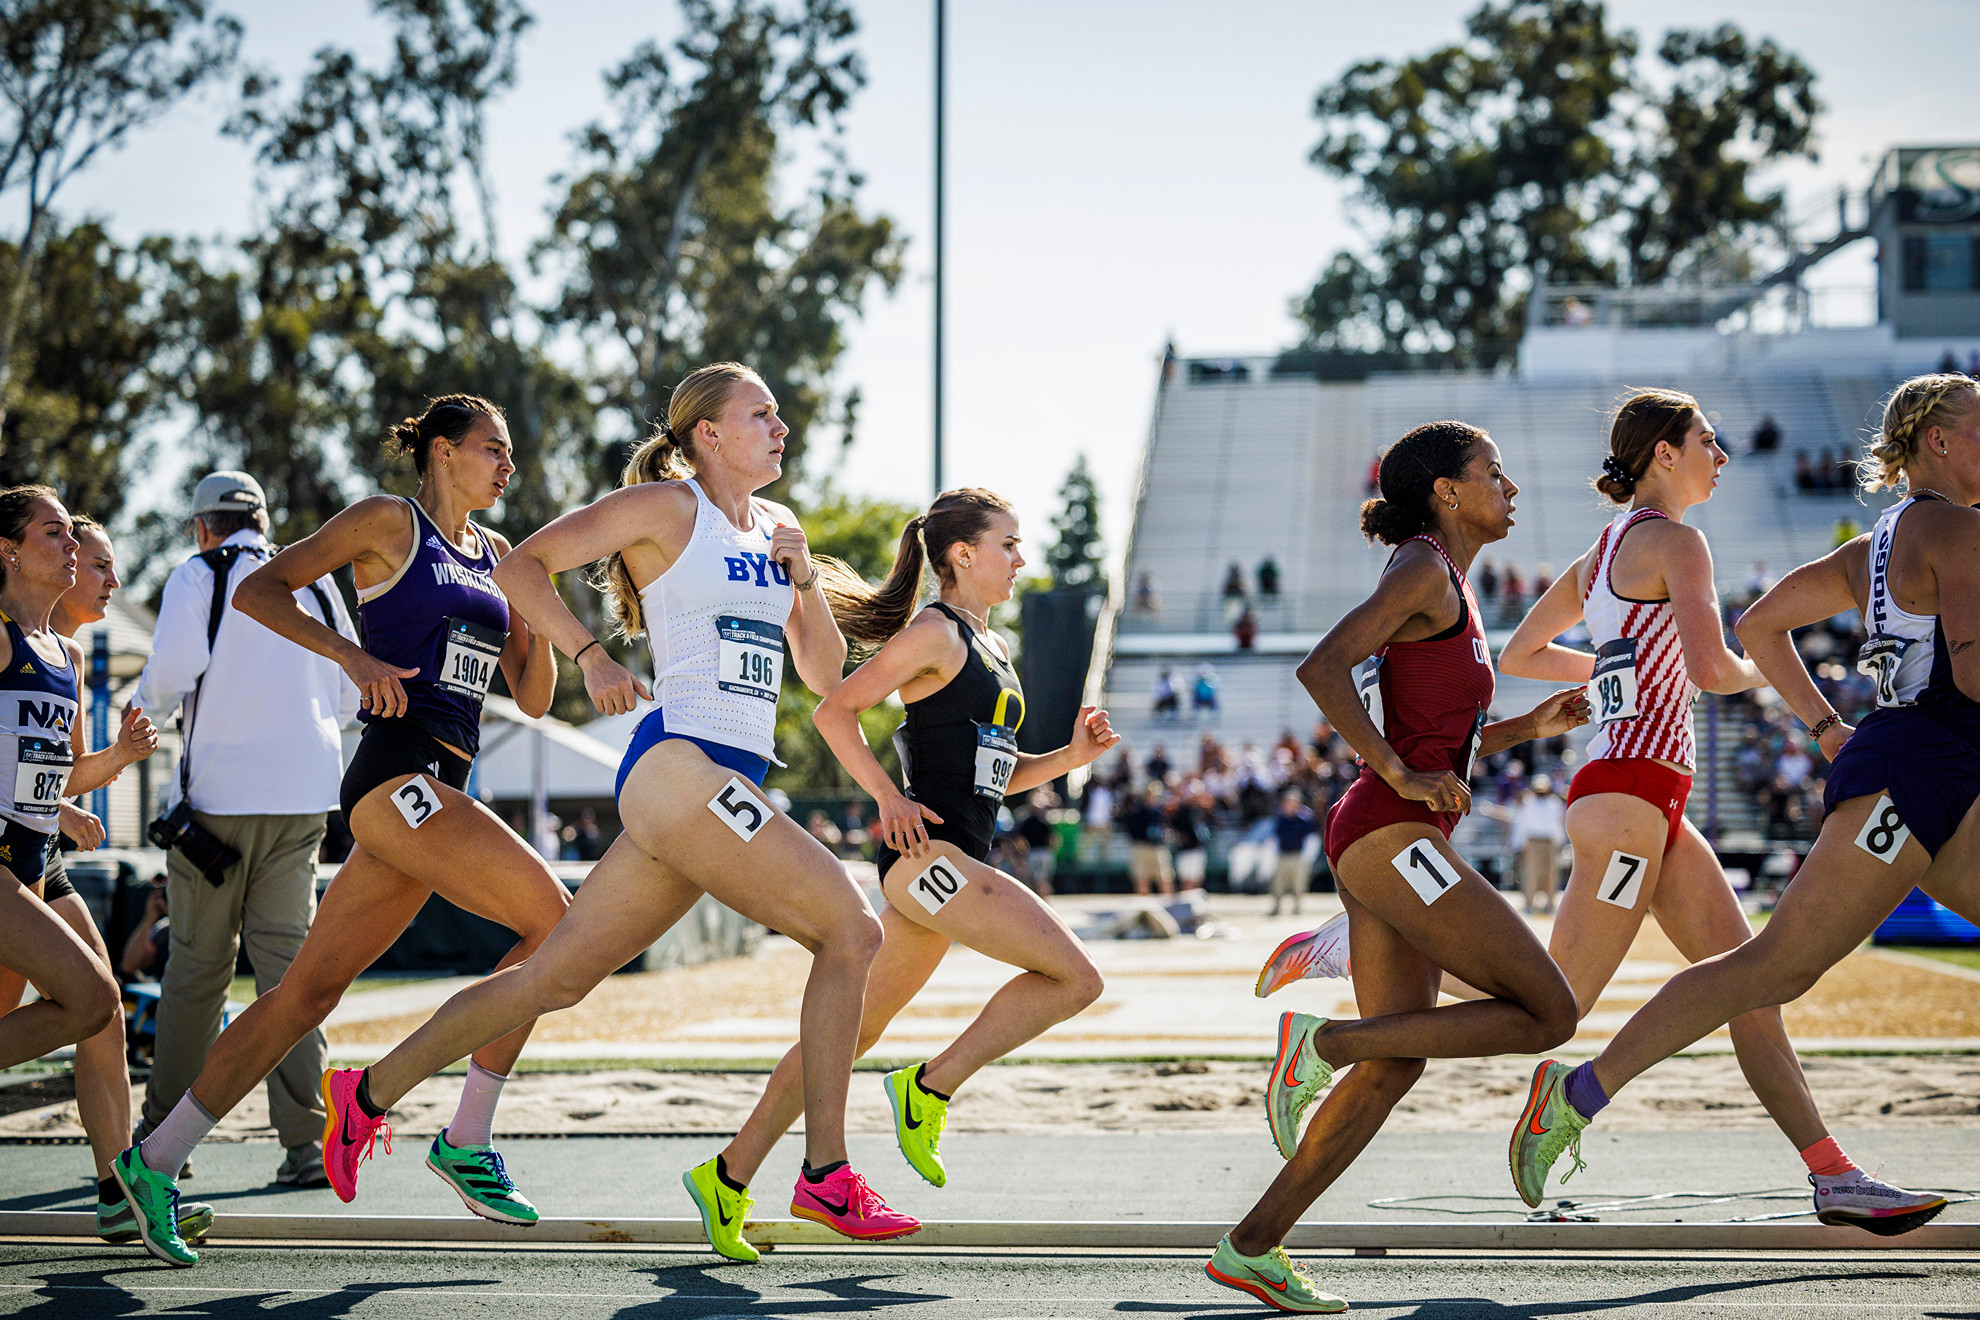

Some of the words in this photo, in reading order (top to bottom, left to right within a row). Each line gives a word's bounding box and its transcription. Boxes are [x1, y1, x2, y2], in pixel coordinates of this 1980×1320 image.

[723, 551, 791, 588] BYU
[452, 652, 488, 688] 1904
[739, 651, 773, 686] 196
[1598, 674, 1623, 717] 189
[33, 772, 64, 801] 875
[399, 784, 432, 824] 3
[717, 785, 762, 833] 5
[1866, 805, 1904, 854] 8
[919, 864, 958, 905] 10
[1410, 846, 1449, 890] 1
[1608, 855, 1640, 901] 7
[1832, 1185, 1855, 1195] new
[1856, 1185, 1902, 1199] balance
